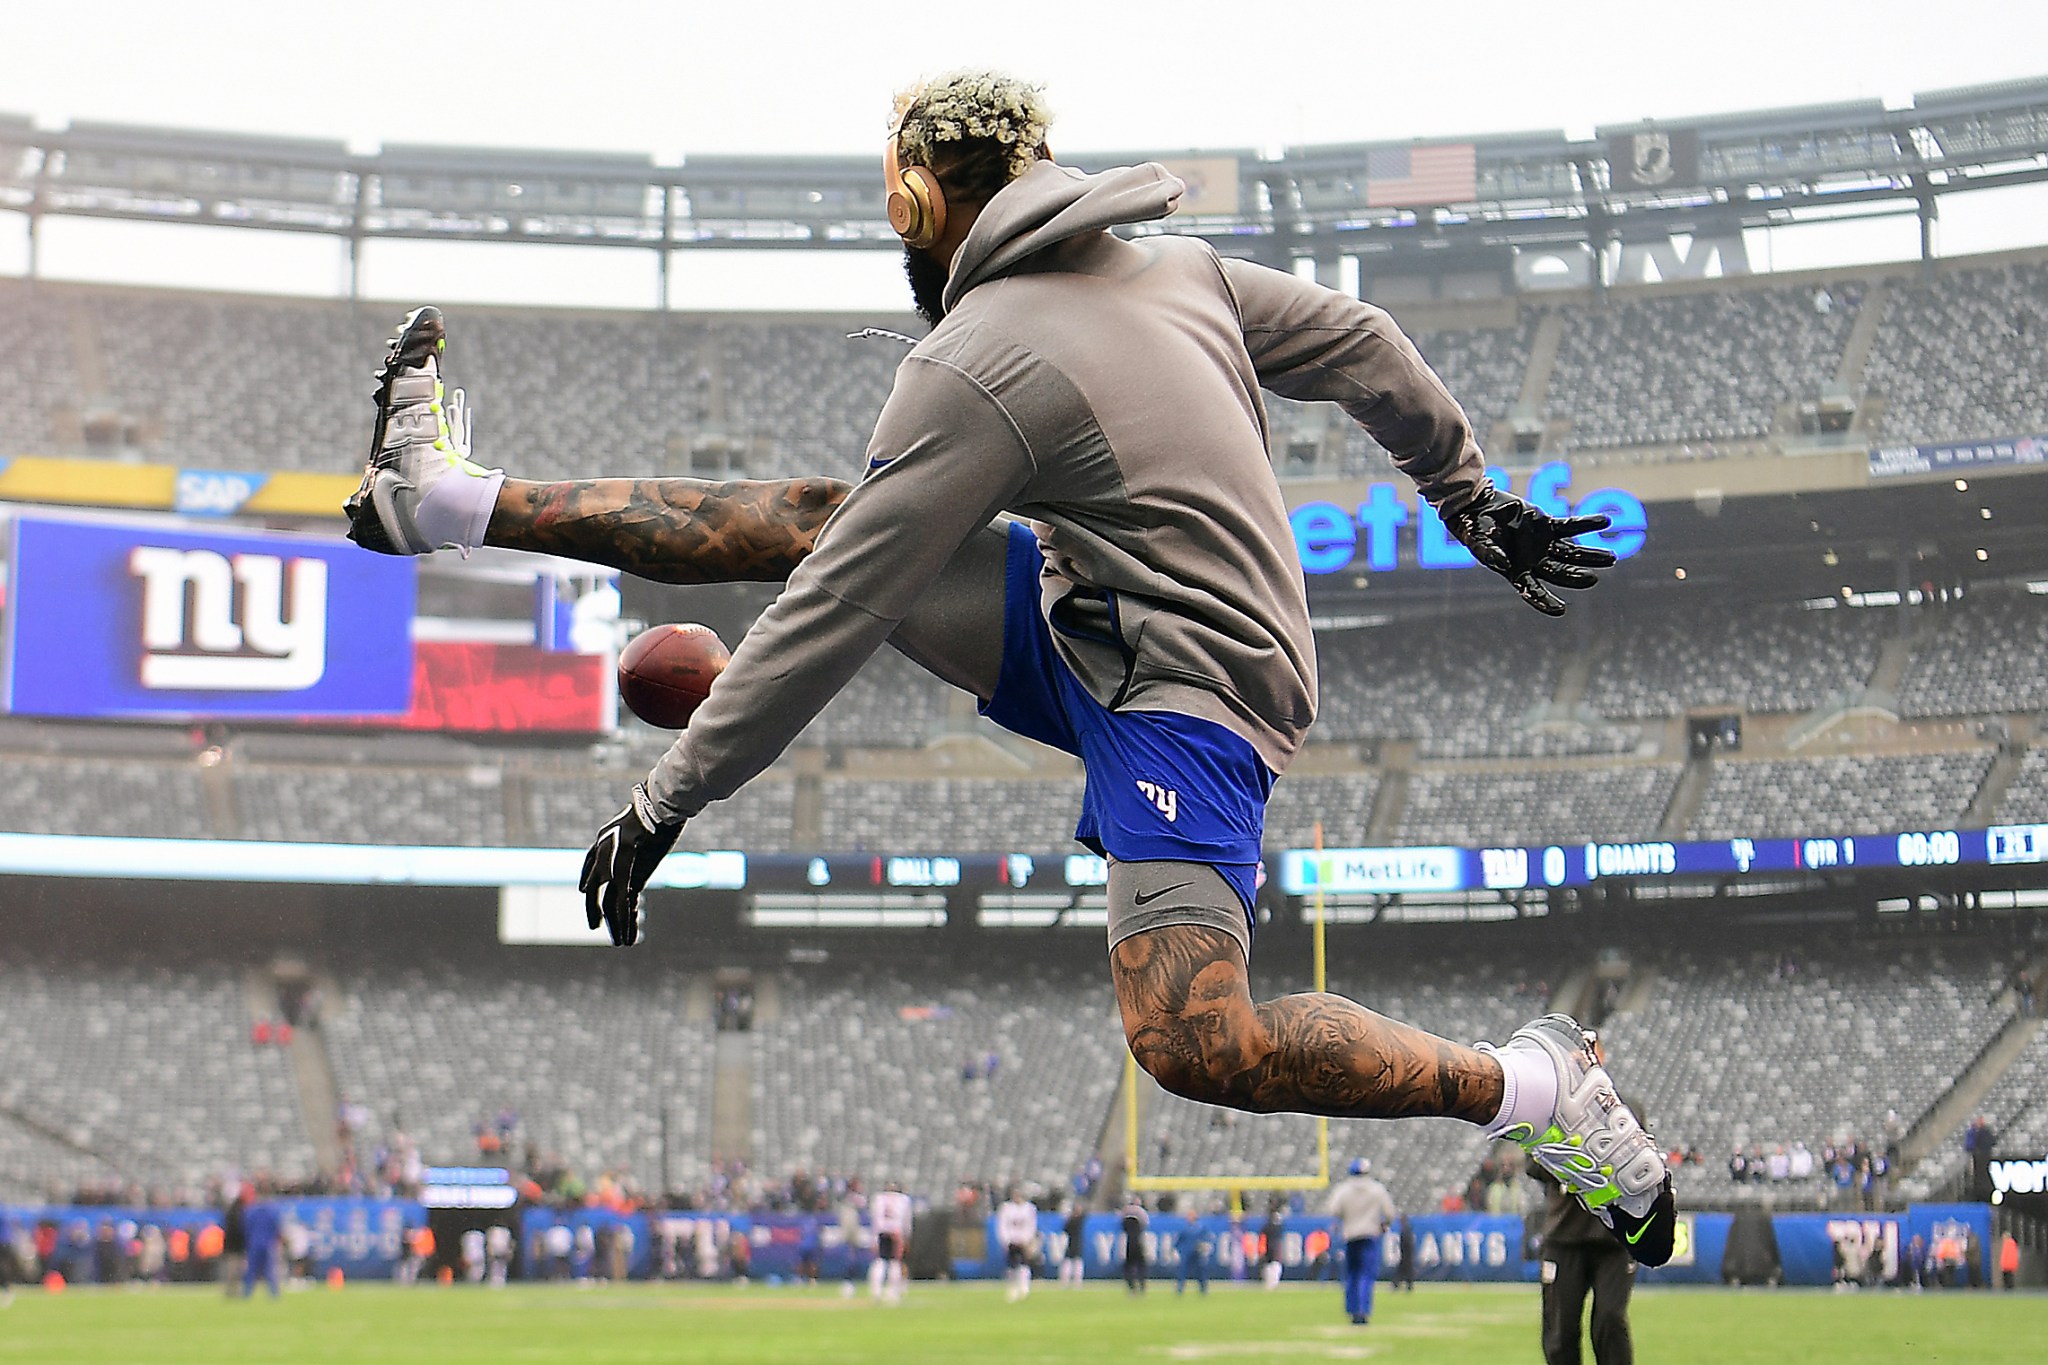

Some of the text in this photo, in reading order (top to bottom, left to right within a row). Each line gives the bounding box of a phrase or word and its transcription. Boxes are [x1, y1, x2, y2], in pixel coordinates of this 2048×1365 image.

[180, 476, 251, 508] SAP
[1346, 863, 1442, 880] MetLife
[1598, 841, 1676, 874] GIANTS
[1382, 1231, 1506, 1267] GANTS
